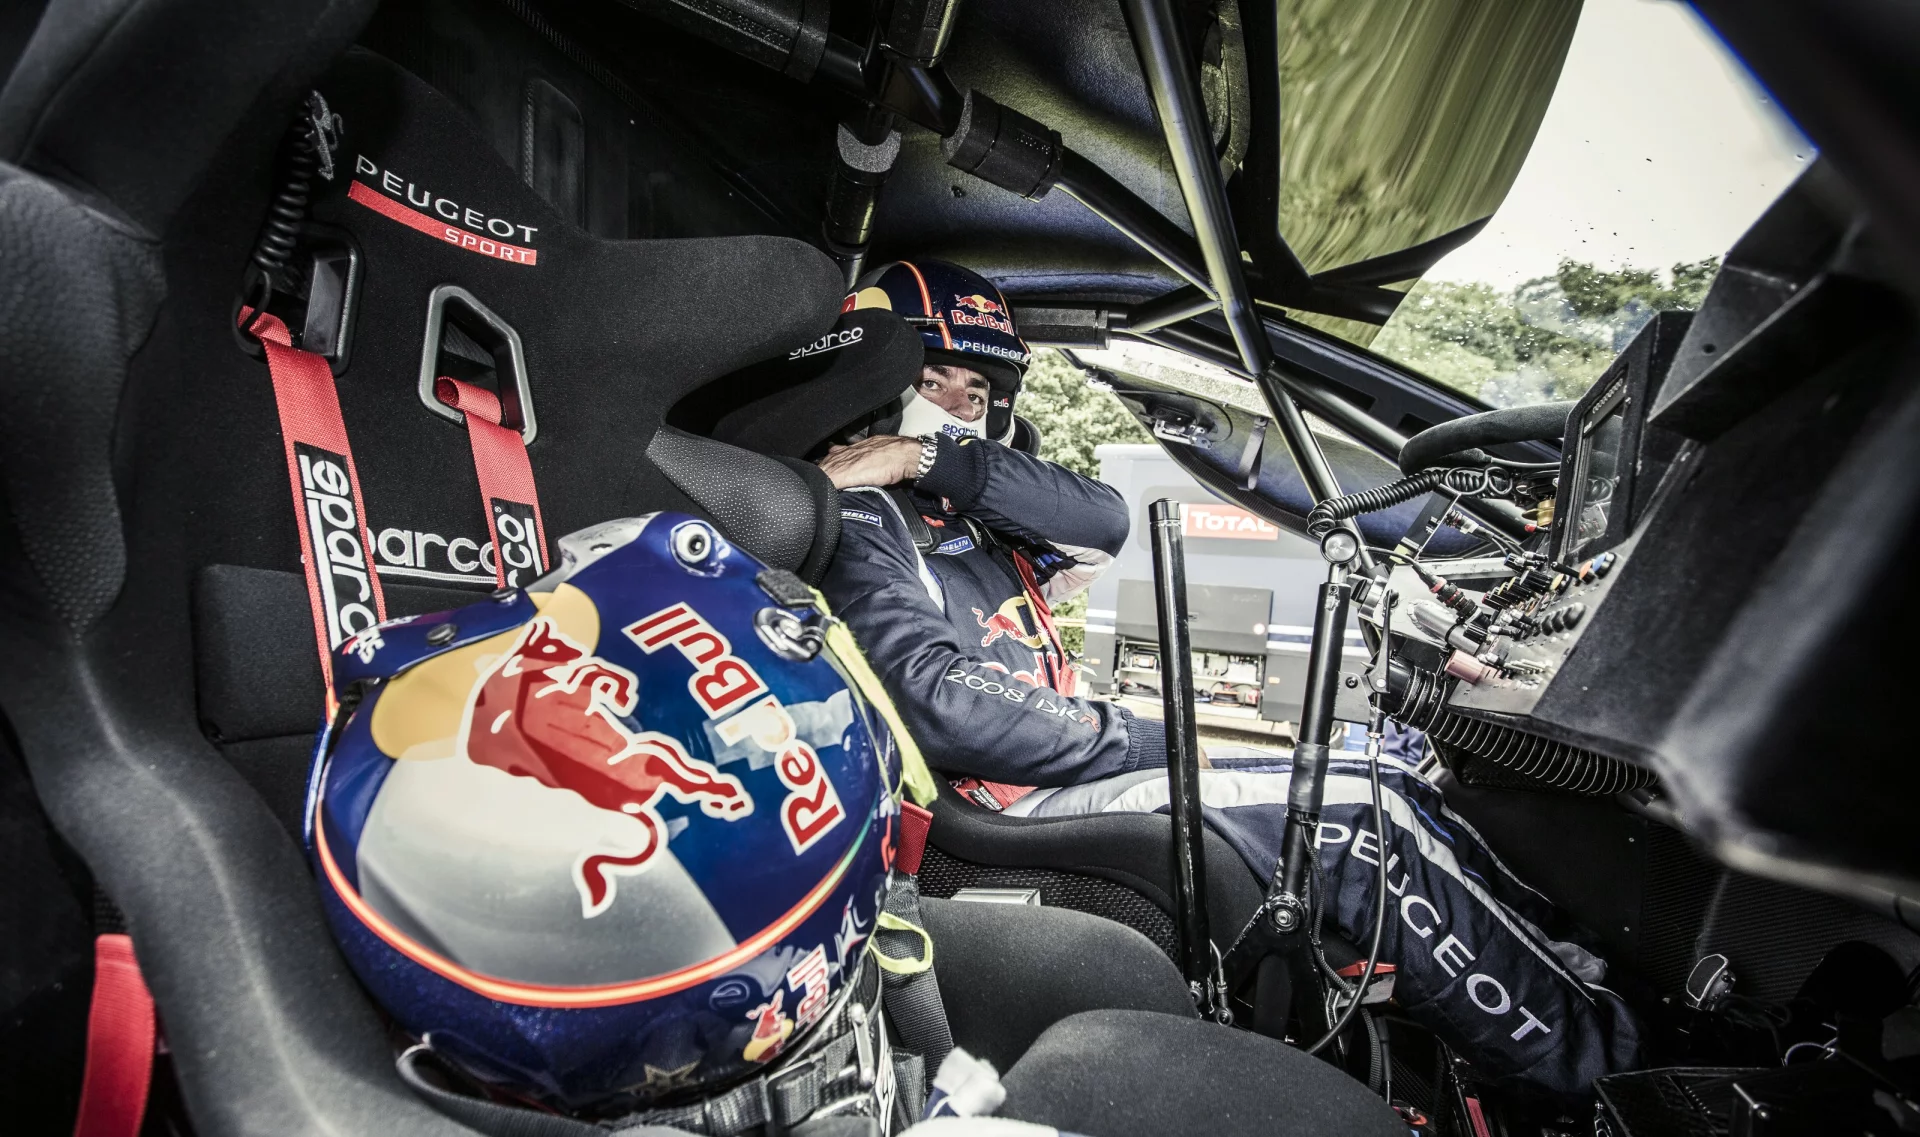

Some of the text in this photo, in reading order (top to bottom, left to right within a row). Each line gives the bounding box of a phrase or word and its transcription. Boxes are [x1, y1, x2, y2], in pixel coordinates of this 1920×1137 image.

[355, 154, 538, 243] PEUGEOT
[445, 228, 531, 263] SPORT
[951, 310, 1014, 336] Red Bull
[788, 327, 863, 361] parco
[962, 340, 1023, 360] PEUGEOT
[841, 510, 879, 522] HELIN
[1190, 511, 1274, 533] TOTAL
[302, 457, 379, 642] sparc
[944, 669, 1025, 703] 2008
[623, 603, 846, 856] Red Bull
[1313, 822, 1552, 1042] PEUGEOT
